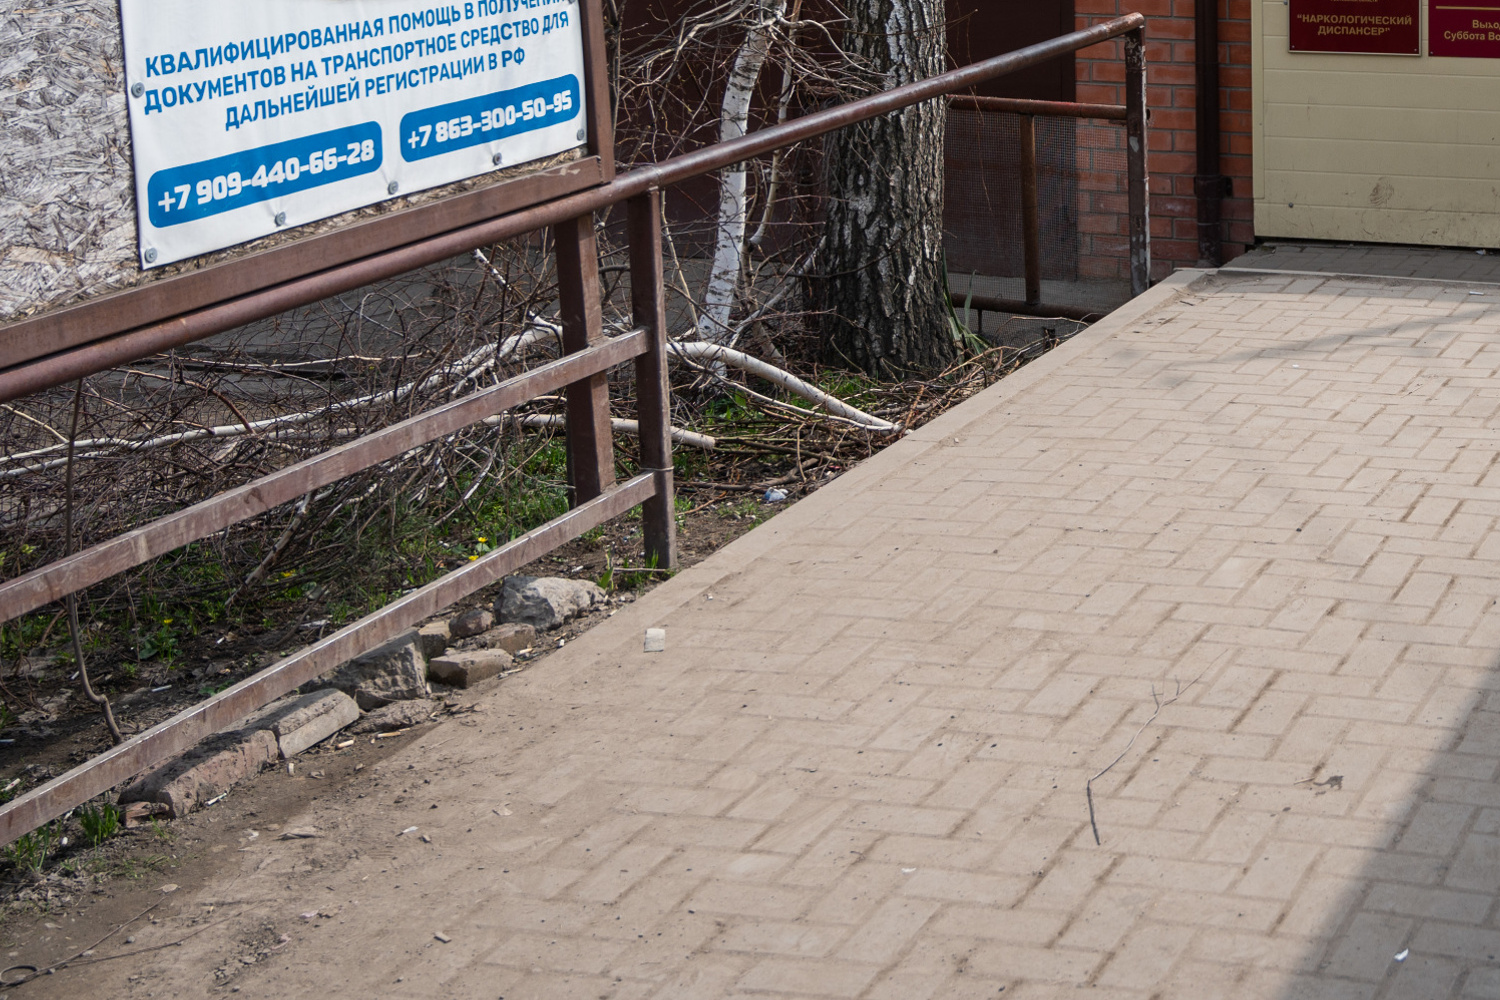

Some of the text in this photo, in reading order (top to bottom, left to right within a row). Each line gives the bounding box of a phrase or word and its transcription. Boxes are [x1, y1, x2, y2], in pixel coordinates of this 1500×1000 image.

[145, 18, 384, 78] КВАЛИФИЦИРОВАННАЯ
[388, 5, 461, 34] ПОМОЩЬ
[464, 2, 474, 20] В
[1297, 14, 1412, 25] "НАРКОЛОГИЧЕСКИЙ
[1317, 26, 1390, 36] ДИСПАНСЕР"
[1444, 30, 1485, 42] Суббота
[144, 10, 569, 116] ДОКУМЕНТОВ НА ТРАНСПОРТНОЕ СРЕДСТВО ДЛЯ
[225, 46, 526, 132] ДАЛЬНЕЙШЕЙ РЕГИСТРАЦИИ В РФ
[407, 89, 573, 149] +7 863-300-50-95
[157, 138, 375, 213] +7 909-440-66-28
